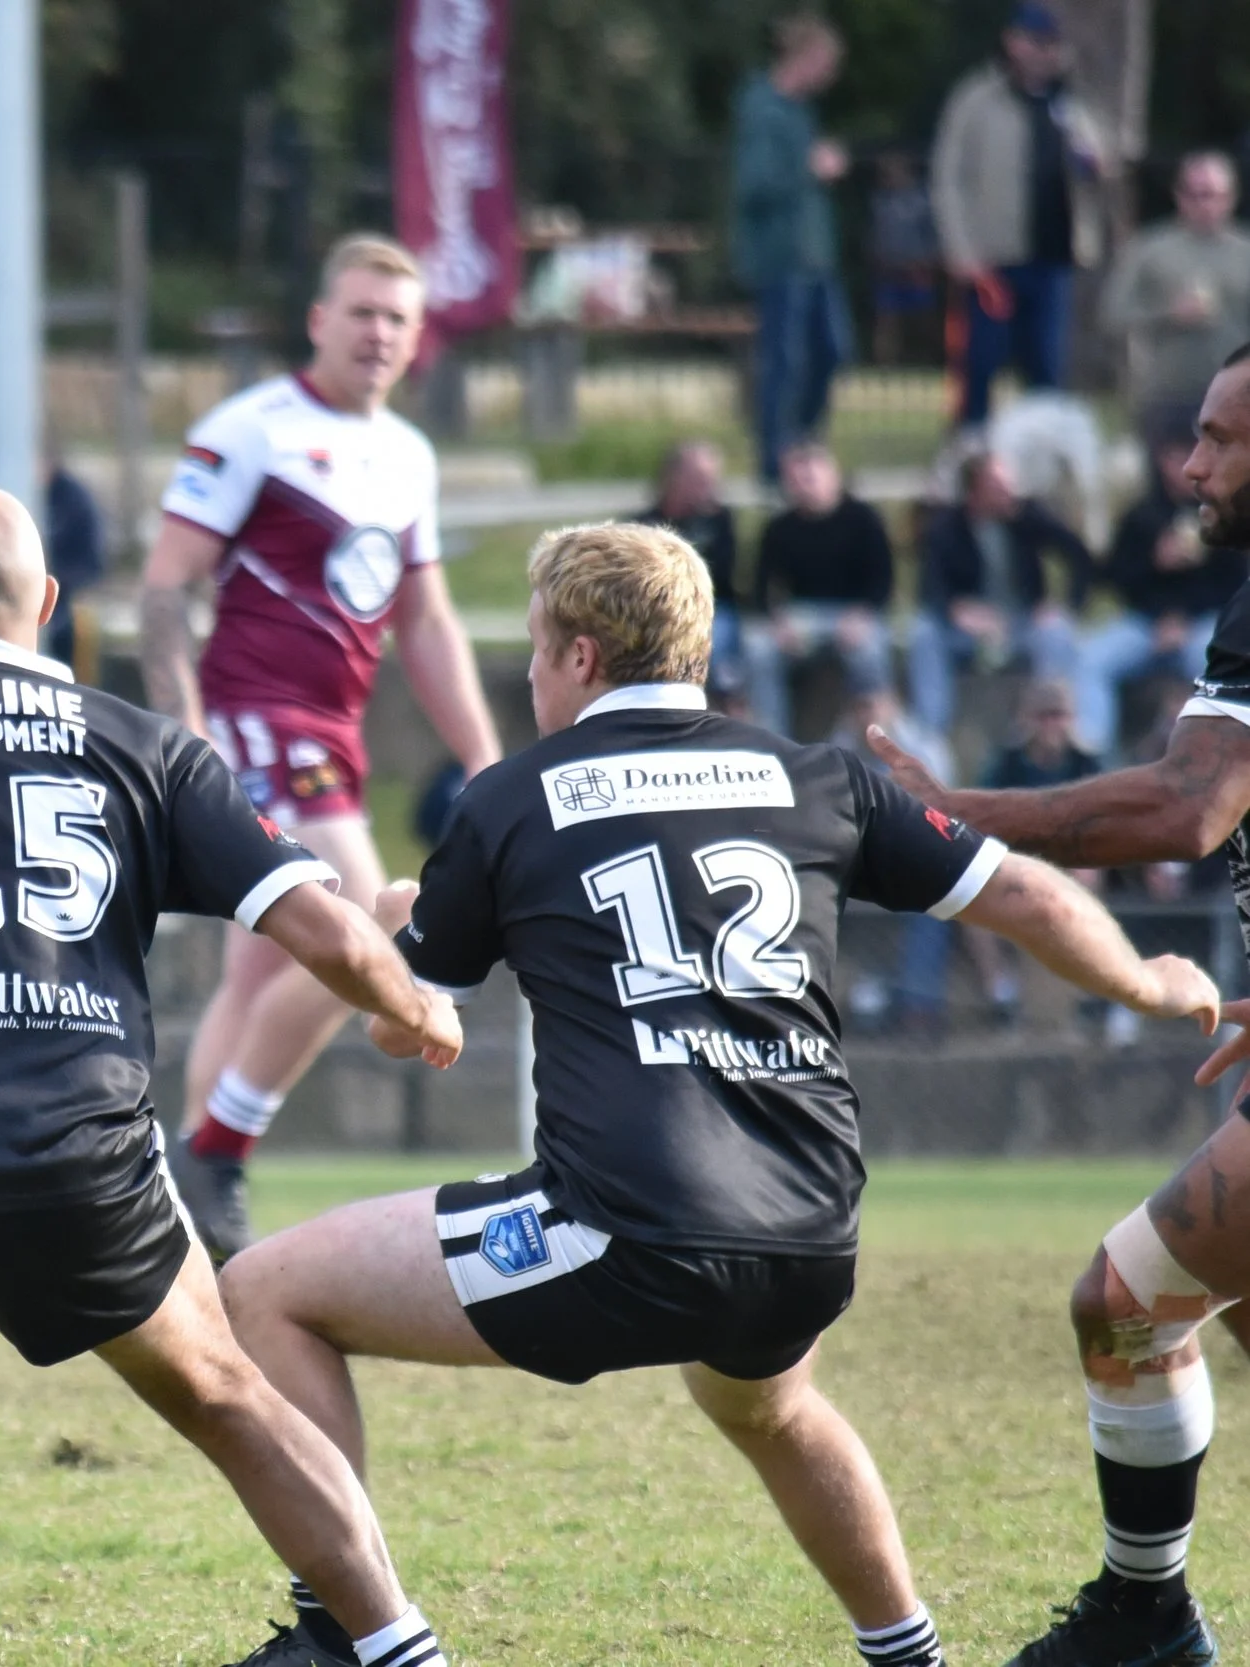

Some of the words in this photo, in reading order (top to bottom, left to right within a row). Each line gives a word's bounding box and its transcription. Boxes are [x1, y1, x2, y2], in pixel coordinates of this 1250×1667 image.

[623, 764, 775, 790] Daneline
[580, 841, 811, 1008] 12
[25, 1016, 57, 1031] Your
[521, 1212, 540, 1252] IGNITE
